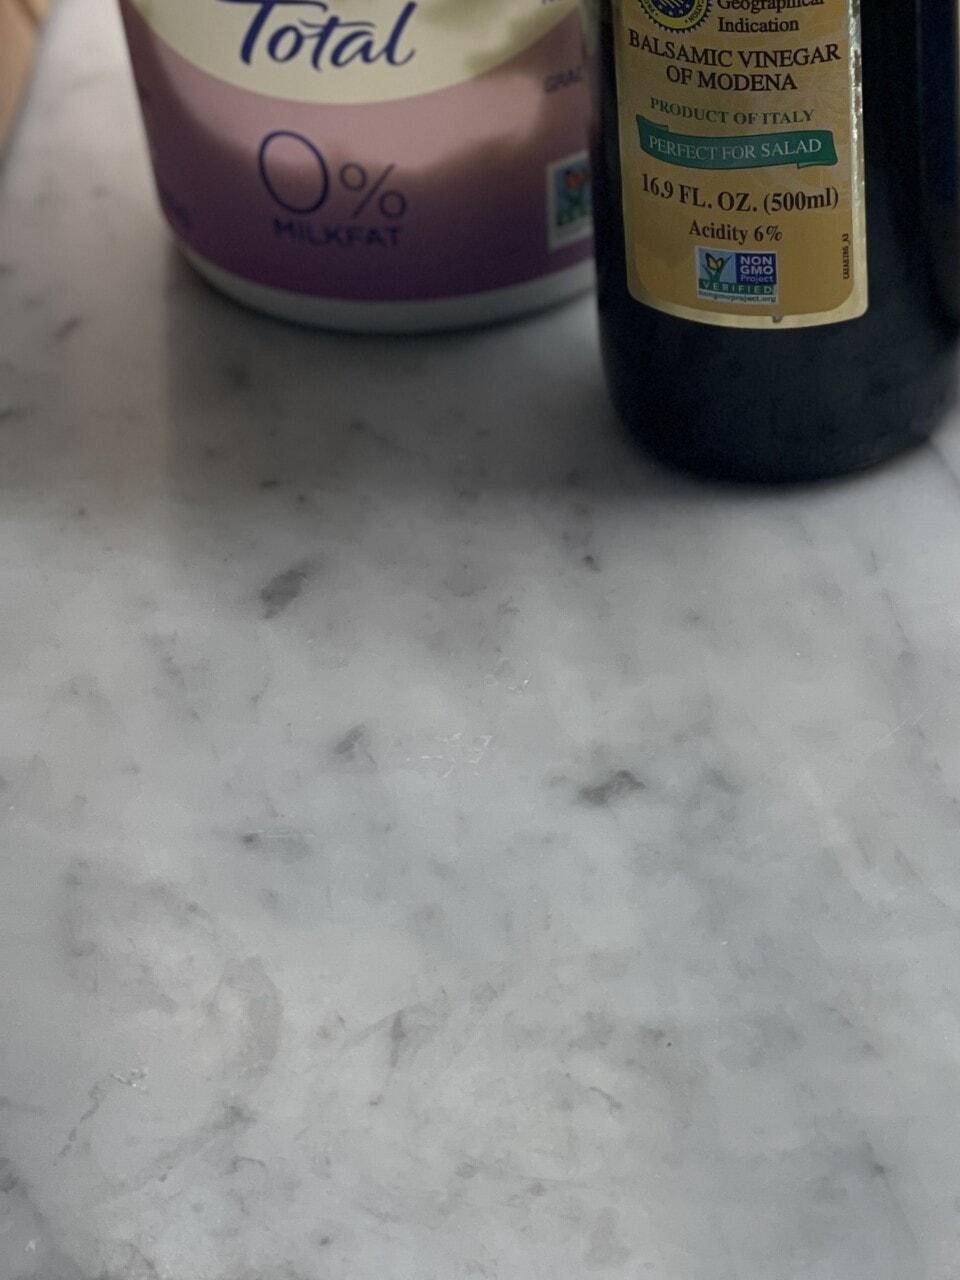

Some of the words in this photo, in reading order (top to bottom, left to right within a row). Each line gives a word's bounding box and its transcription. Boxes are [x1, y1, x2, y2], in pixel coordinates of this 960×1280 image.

[718, 16, 800, 33] Indication
[629, 28, 733, 67] BALSAMIC
[736, 43, 842, 69] VINEGAR
[666, 64, 693, 85] OF
[697, 70, 798, 92] MODENA
[650, 97, 729, 124] PRODUCT
[734, 112, 756, 125] OF
[762, 108, 815, 125] ITALY
[649, 134, 718, 161] PERFECT
[722, 145, 755, 161] FOR
[761, 138, 822, 158] SALAD
[258, 129, 409, 220] 0%
[642, 173, 674, 199] 16.9
[678, 184, 713, 209] FL.
[717, 191, 758, 213] OZ.
[763, 186, 839, 215] (500ml)
[274, 217, 403, 248] MILKFAT
[689, 219, 748, 245] Acidity
[753, 224, 783, 242] 6%
[740, 256, 773, 266] NON
[740, 265, 774, 275] GMO
[702, 281, 772, 294] VERIFIED
[740, 274, 774, 284] Project
